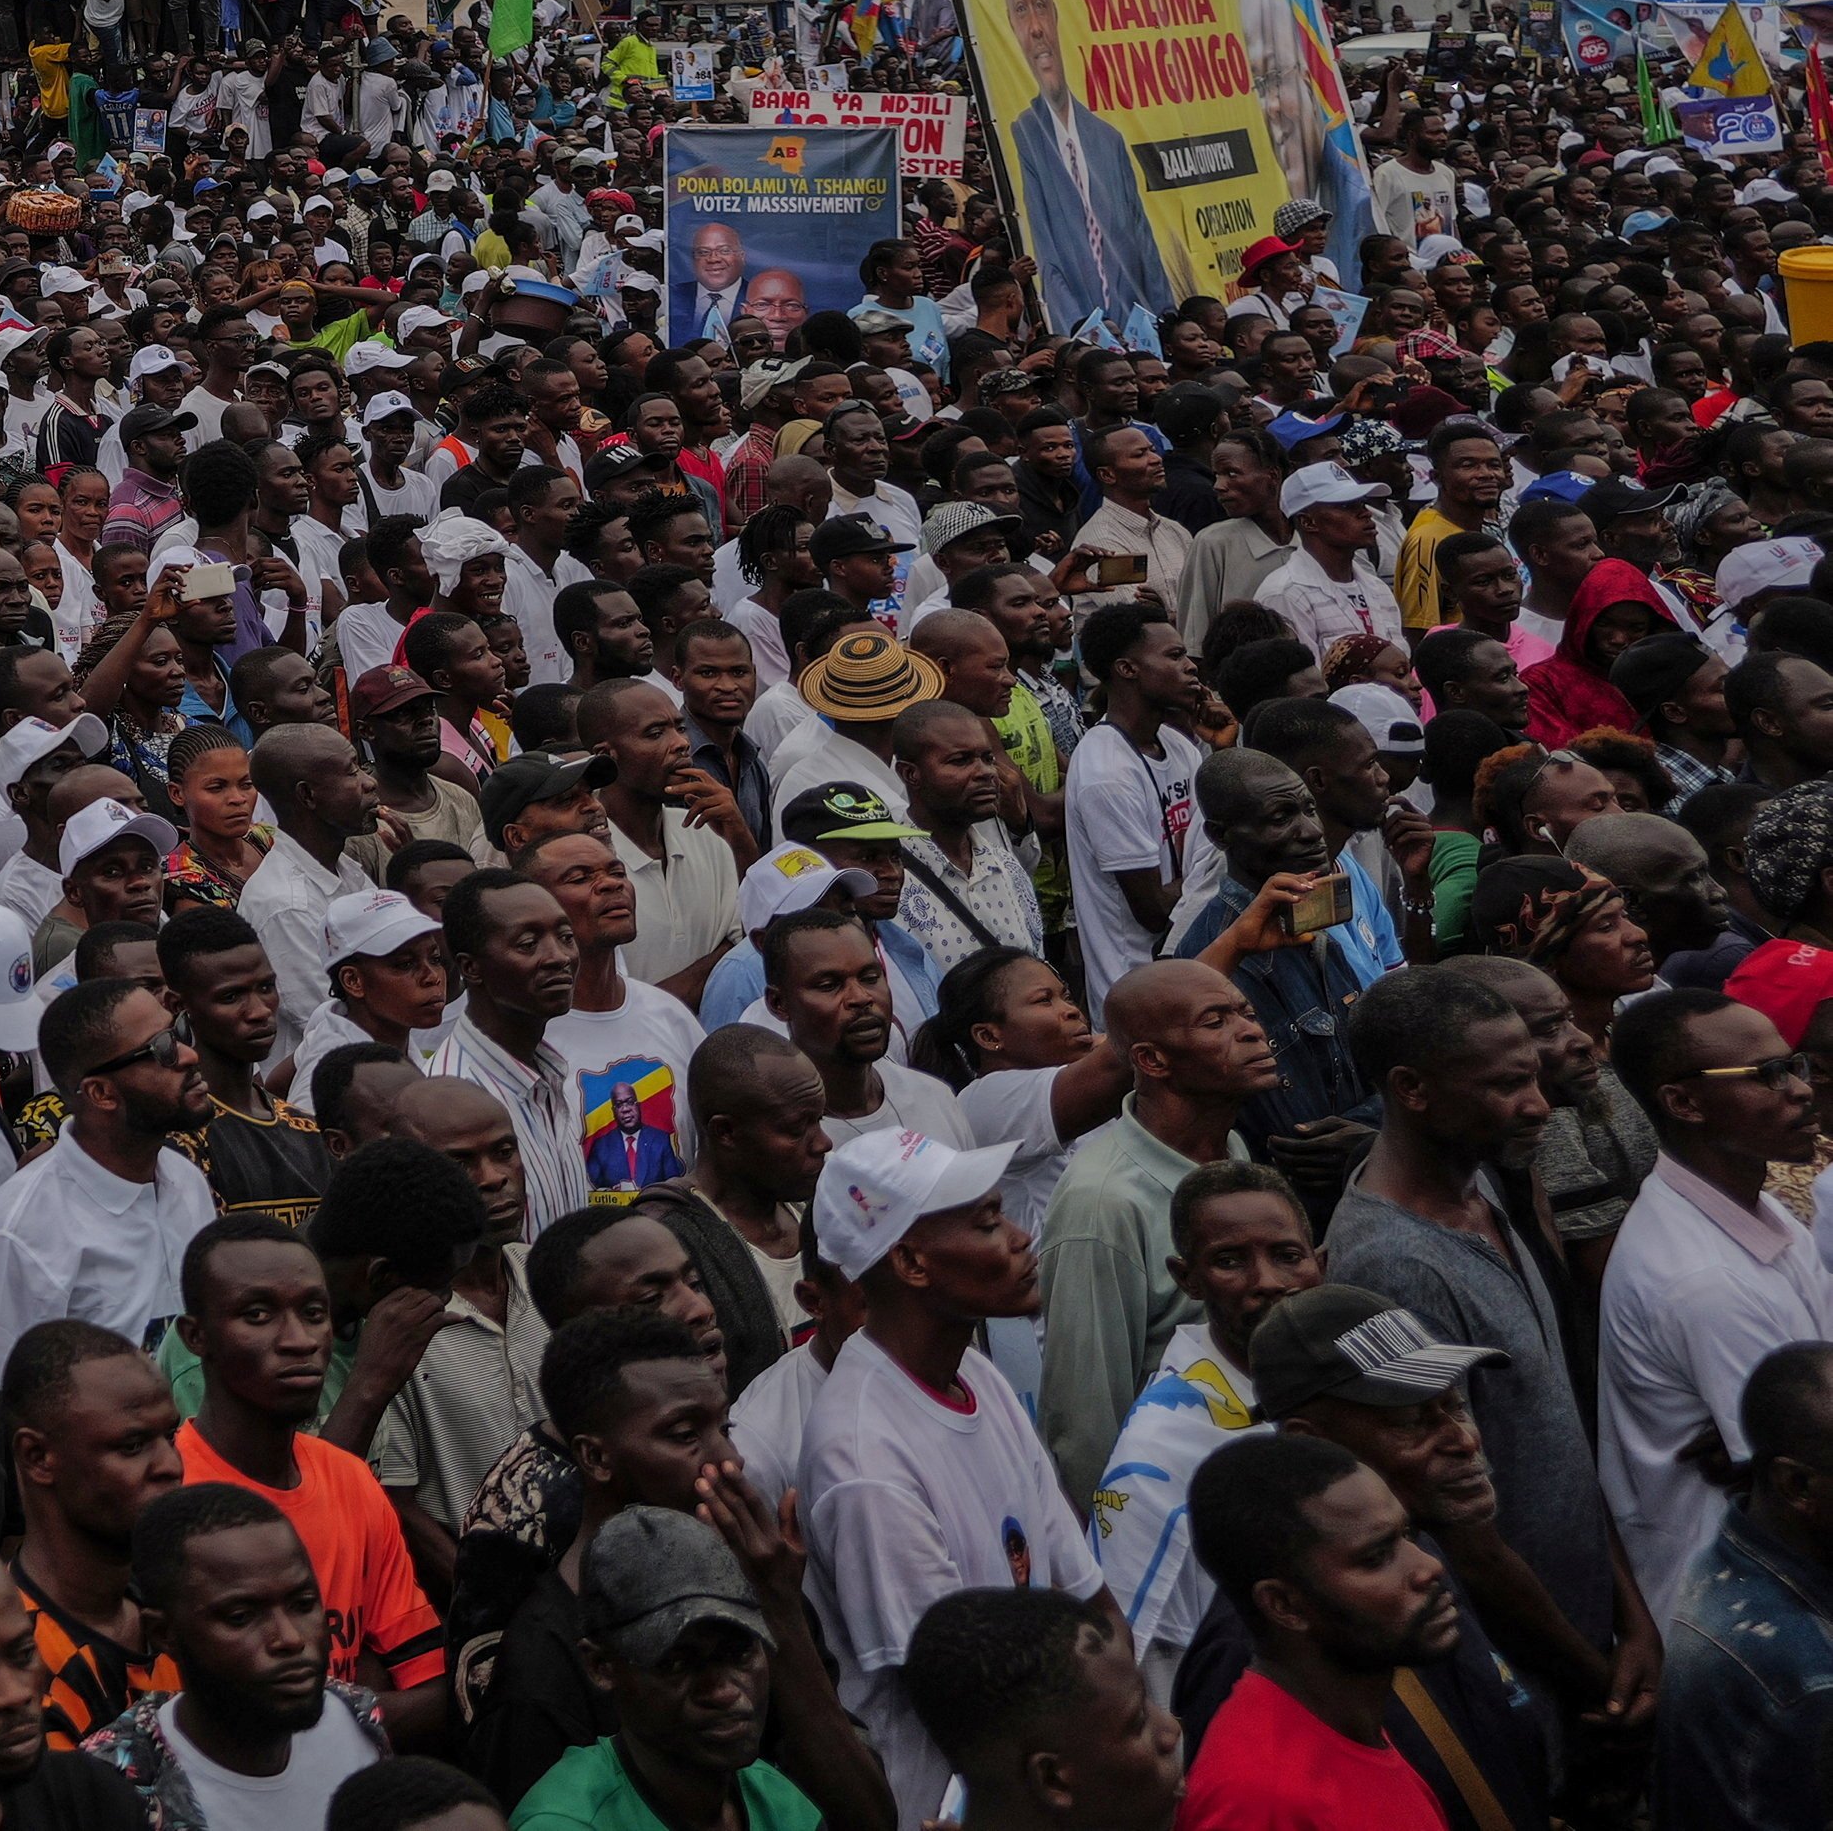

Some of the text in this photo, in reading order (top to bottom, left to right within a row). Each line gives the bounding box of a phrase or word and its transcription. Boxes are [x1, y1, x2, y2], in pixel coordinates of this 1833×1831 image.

[1078, 32, 1251, 113] MUNGONGO
[752, 90, 952, 116] BANA YA NDJILI
[105, 112, 132, 139] 11
[677, 177, 887, 195] PONA BOLAMU YA TSHANGU
[692, 196, 863, 213] VOTEZ MASSSIVEMENT
